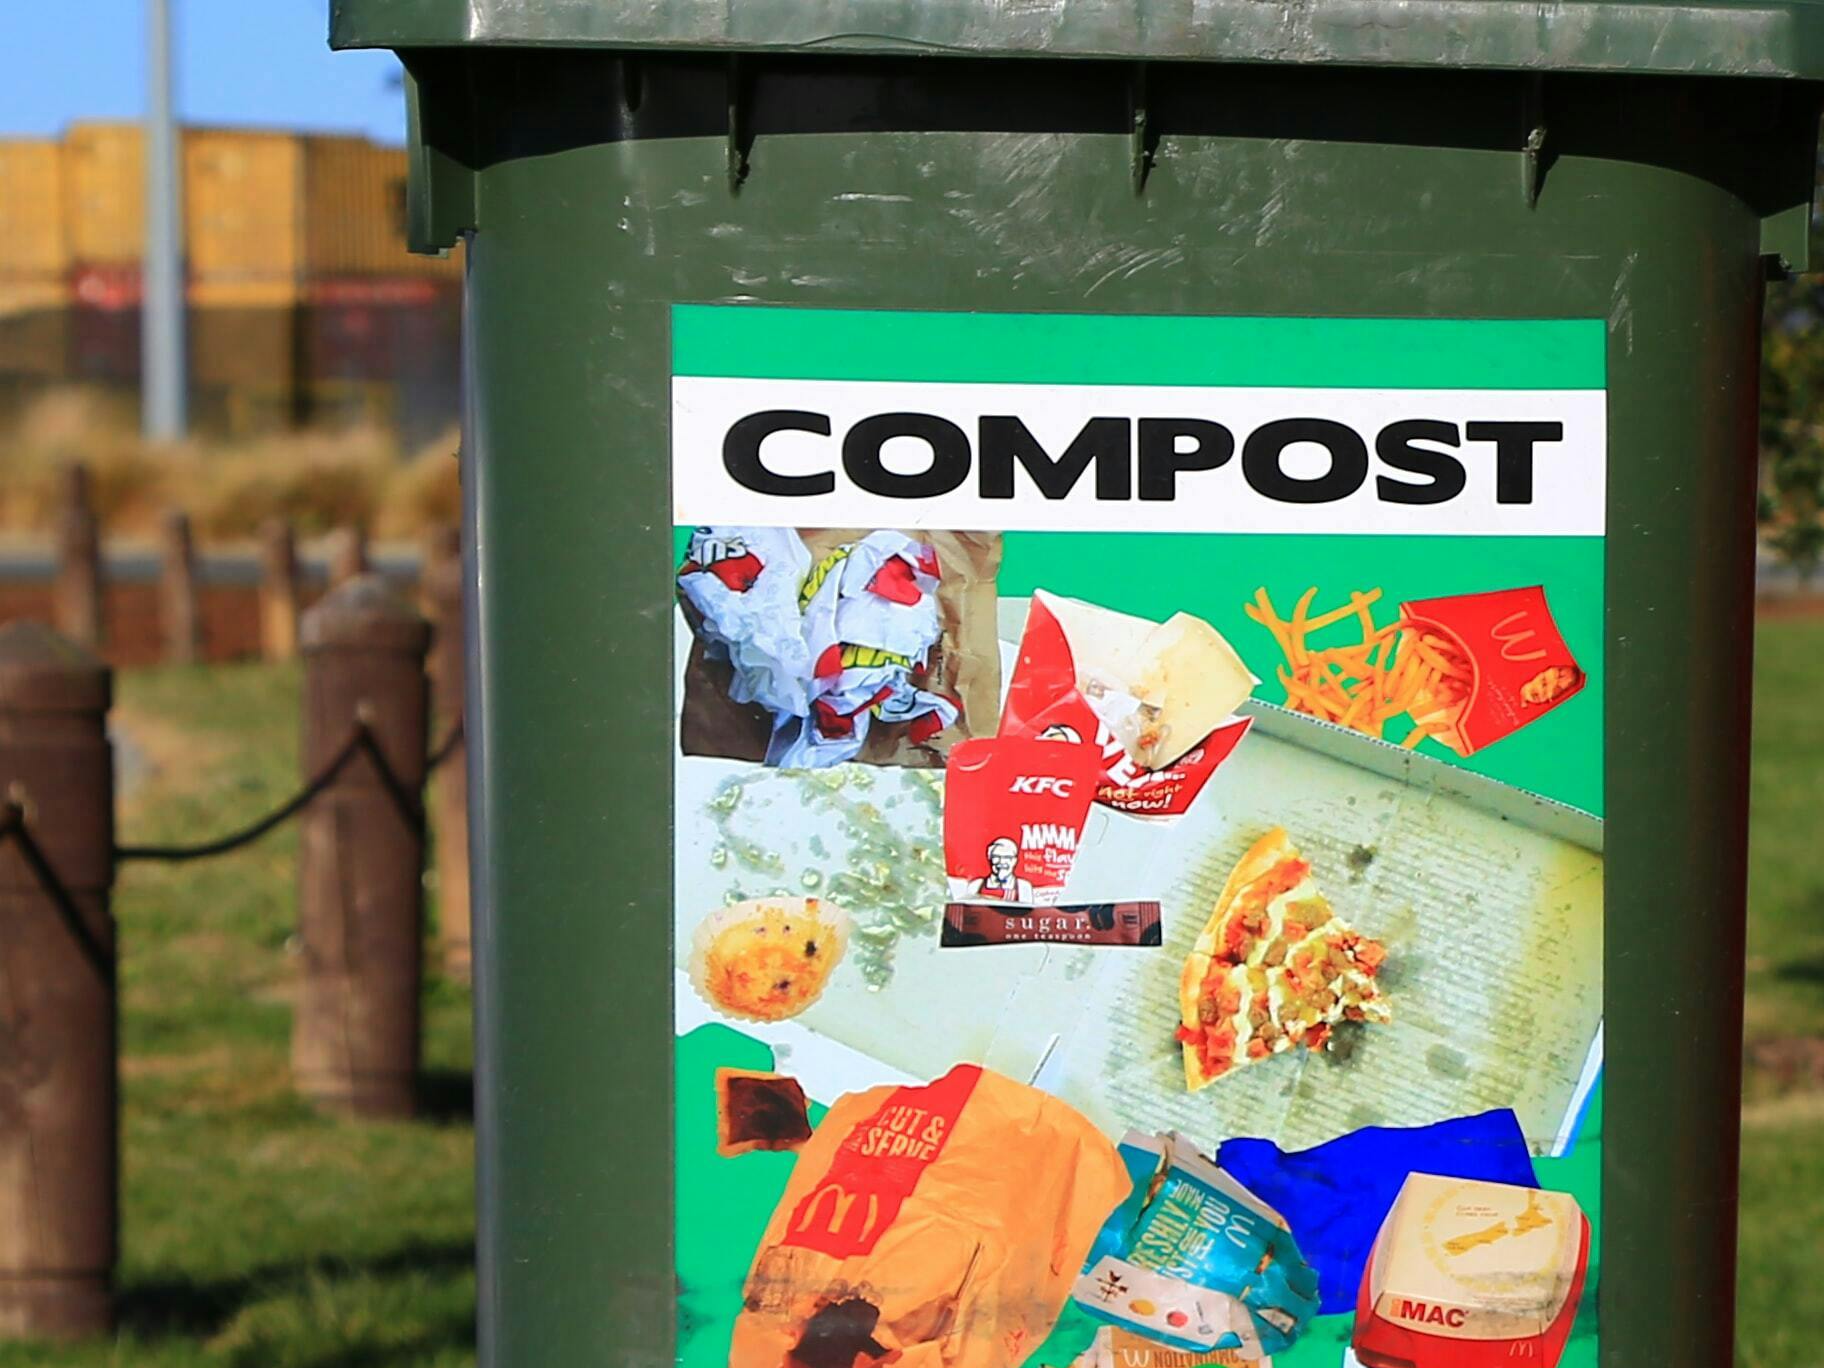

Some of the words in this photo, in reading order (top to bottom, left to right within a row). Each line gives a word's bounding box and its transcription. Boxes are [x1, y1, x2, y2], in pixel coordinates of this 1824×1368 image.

[722, 409, 1563, 504] COMPOST
[1008, 776, 1074, 798] KFC
[1005, 915, 1092, 932] sugar.
[878, 1104, 928, 1137] CUT
[921, 1115, 946, 1145] &
[860, 1126, 937, 1161] SERVE
[1400, 1299, 1466, 1328] MAC
